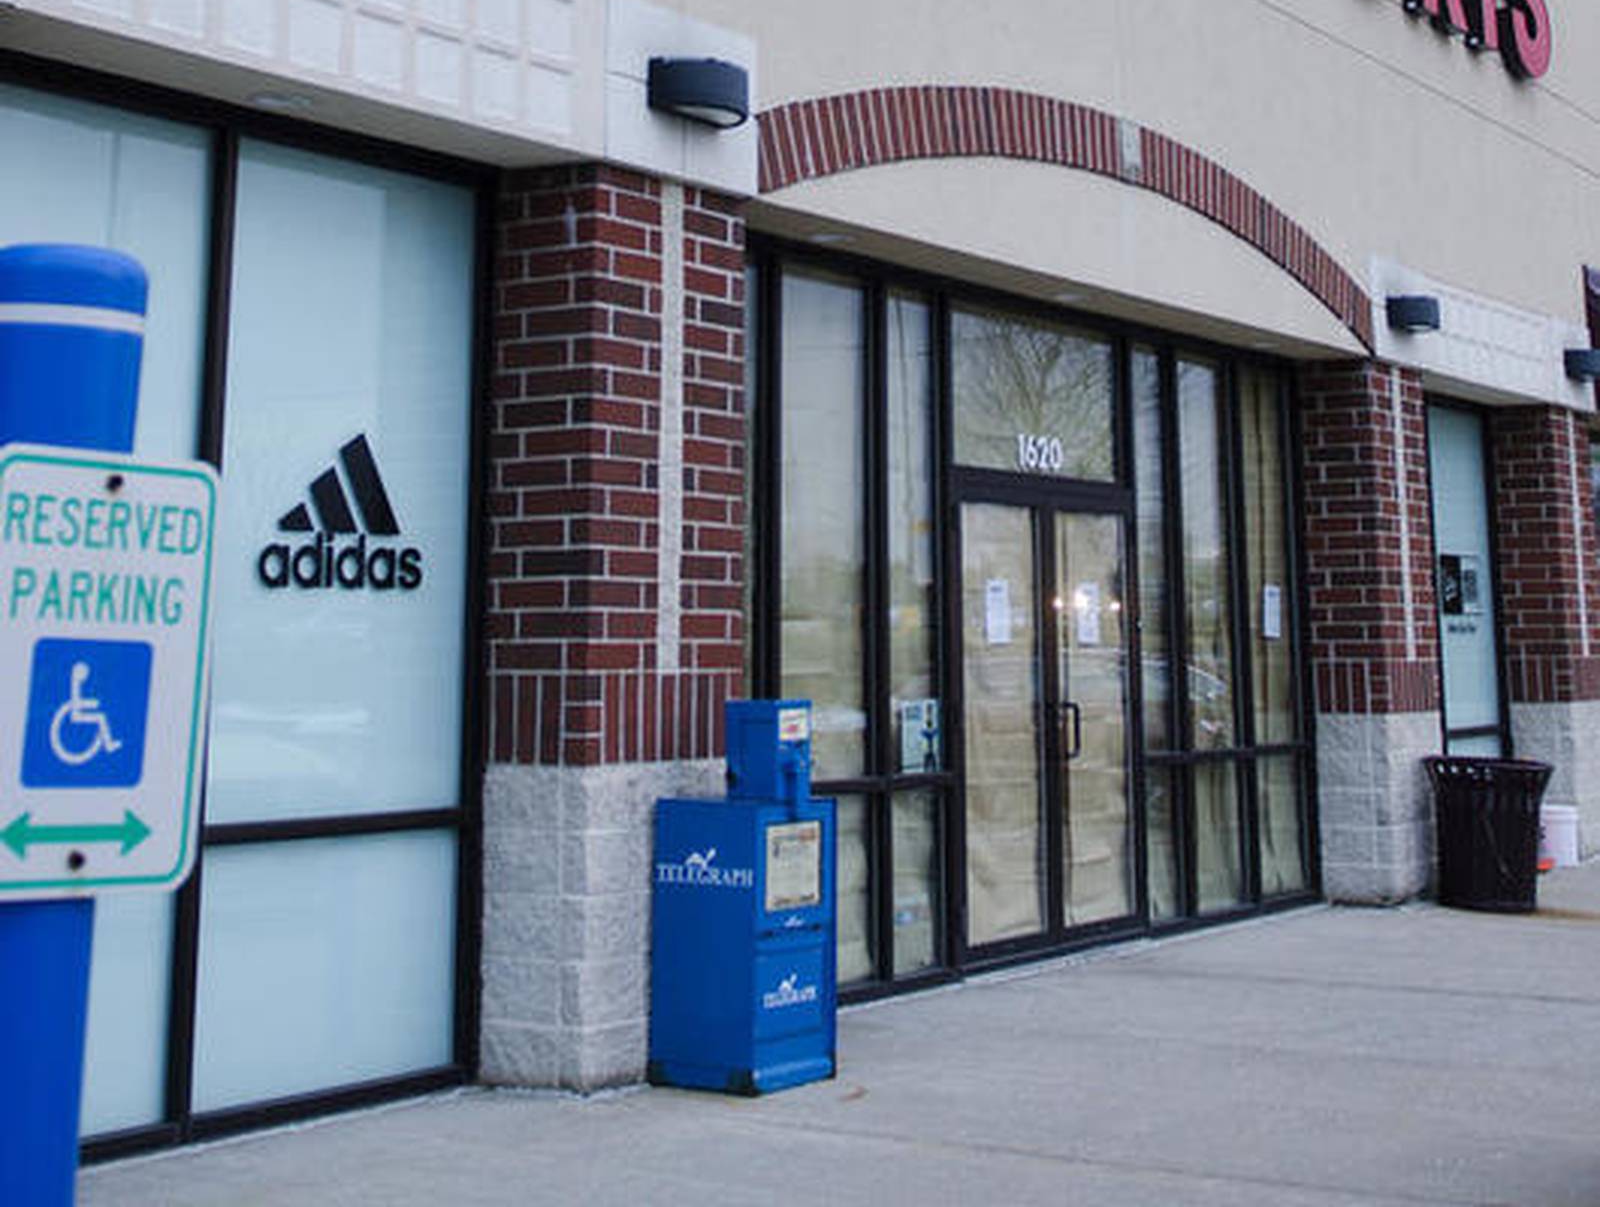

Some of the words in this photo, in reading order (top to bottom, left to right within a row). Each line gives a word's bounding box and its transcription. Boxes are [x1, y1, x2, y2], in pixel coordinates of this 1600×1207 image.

[1018, 433, 1063, 470] 1620
[3, 492, 201, 554] RESERVED
[258, 531, 423, 589] adidas
[10, 568, 184, 625] PARKING
